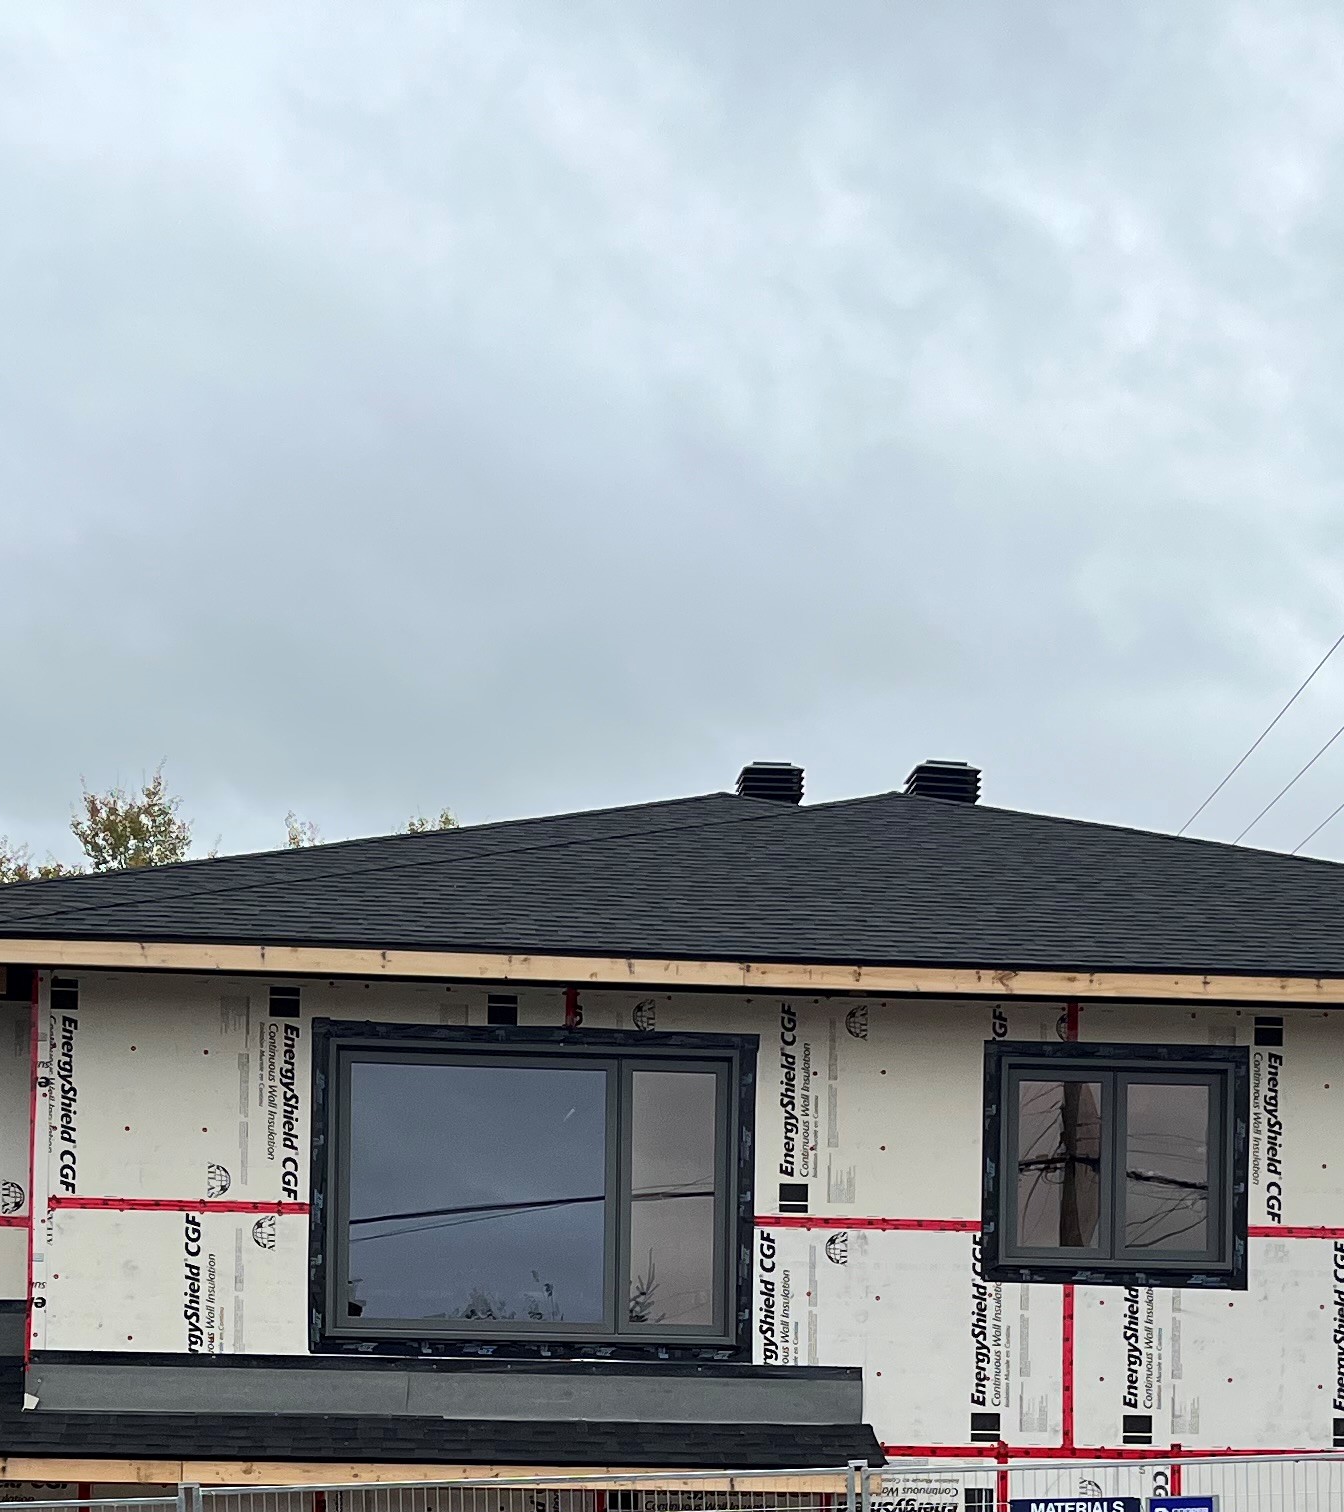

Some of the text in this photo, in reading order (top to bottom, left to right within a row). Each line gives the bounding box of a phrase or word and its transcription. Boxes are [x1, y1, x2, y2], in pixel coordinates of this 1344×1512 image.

[859, 1005, 869, 1041] ATLAS
[57, 1015, 78, 1194] EnergyShield CGF
[267, 1023, 279, 1161] Continuous Wall Insulation
[280, 1023, 300, 1200] EnergyShield CGF
[779, 1003, 798, 1178] EnergyShield CGF
[800, 1043, 811, 1178] Continuous Wall Insulation
[1253, 1111, 1262, 1135] Wall
[1264, 1052, 1283, 1224] EnergyShield CGF
[207, 1161, 217, 1199] ATLAS
[184, 1213, 202, 1257] CGF
[760, 1230, 776, 1273] CGF
[206, 1253, 216, 1329] Wall Insulation
[781, 1270, 790, 1319] Insulation
[780, 1320, 790, 1344] Wall
[971, 1283, 990, 1407] EnergyShield
[992, 1327, 1002, 1349] Wall
[1143, 1330, 1153, 1352] Wall
[991, 1351, 1002, 1407] Continuous
[1143, 1353, 1154, 1410] Continuous
[902, 1487, 959, 1497] Continuous
